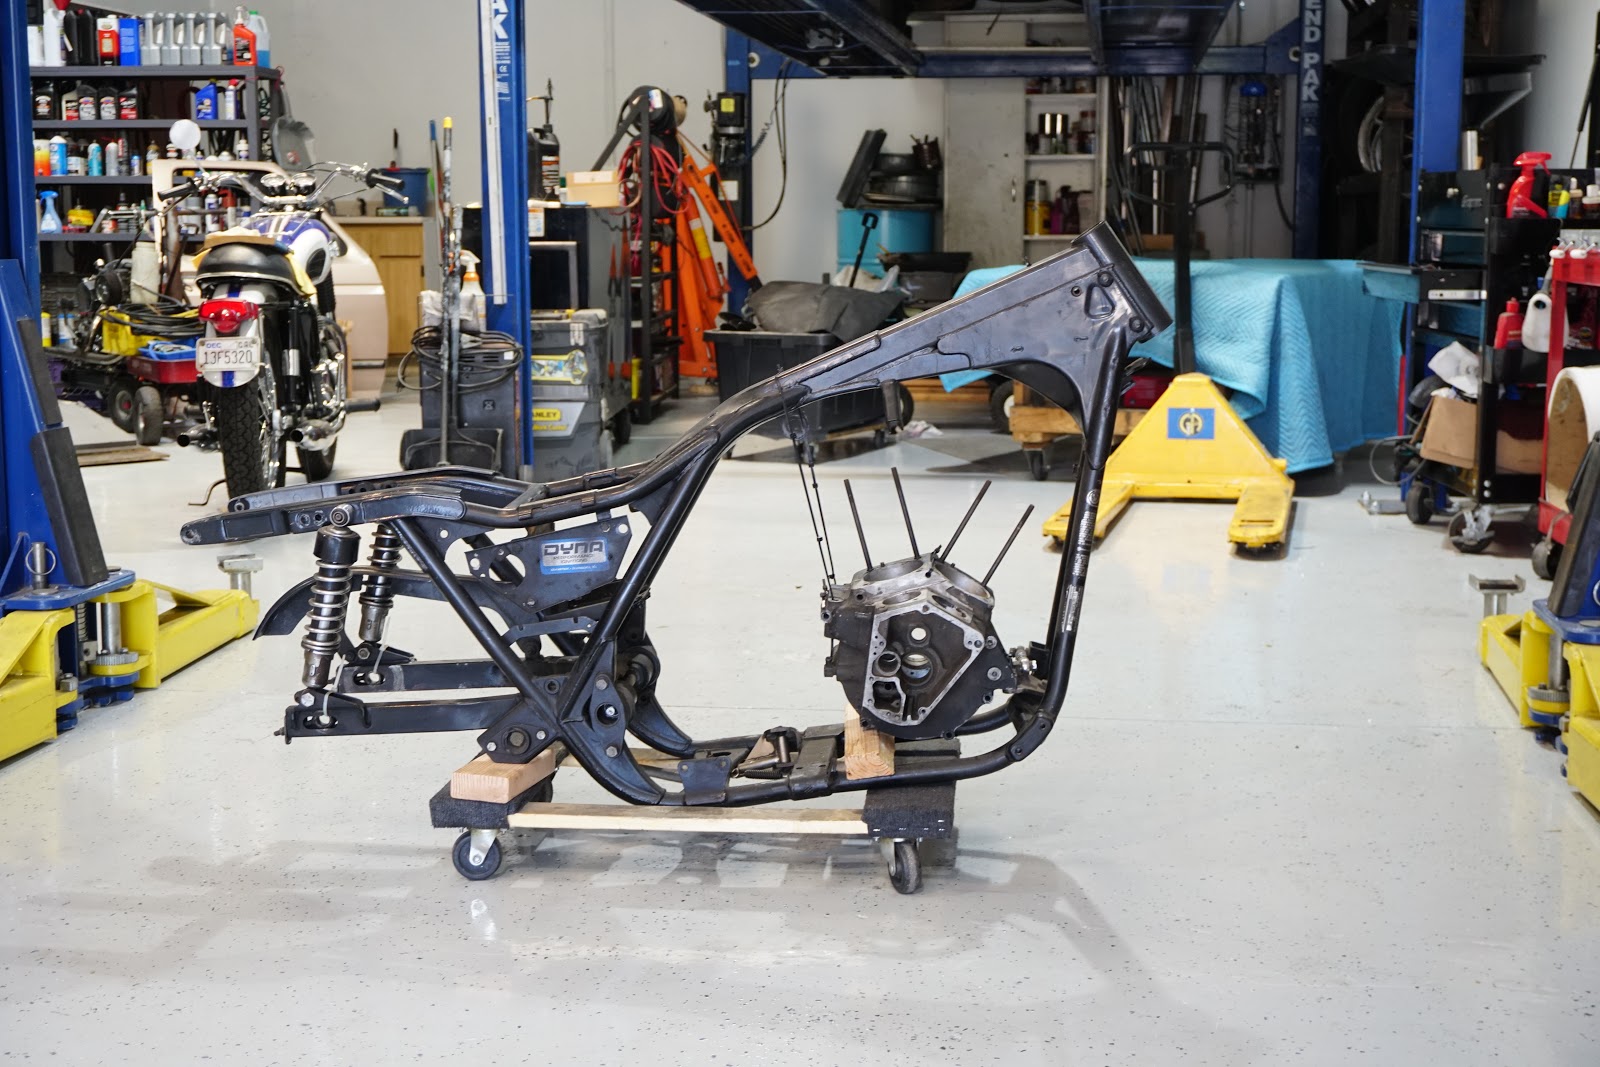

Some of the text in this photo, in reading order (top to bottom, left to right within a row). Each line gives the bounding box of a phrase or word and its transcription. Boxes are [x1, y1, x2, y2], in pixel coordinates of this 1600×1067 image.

[1302, 52, 1320, 101] PAK
[204, 350, 252, 365] 13F5320
[544, 541, 603, 556] DYNA
